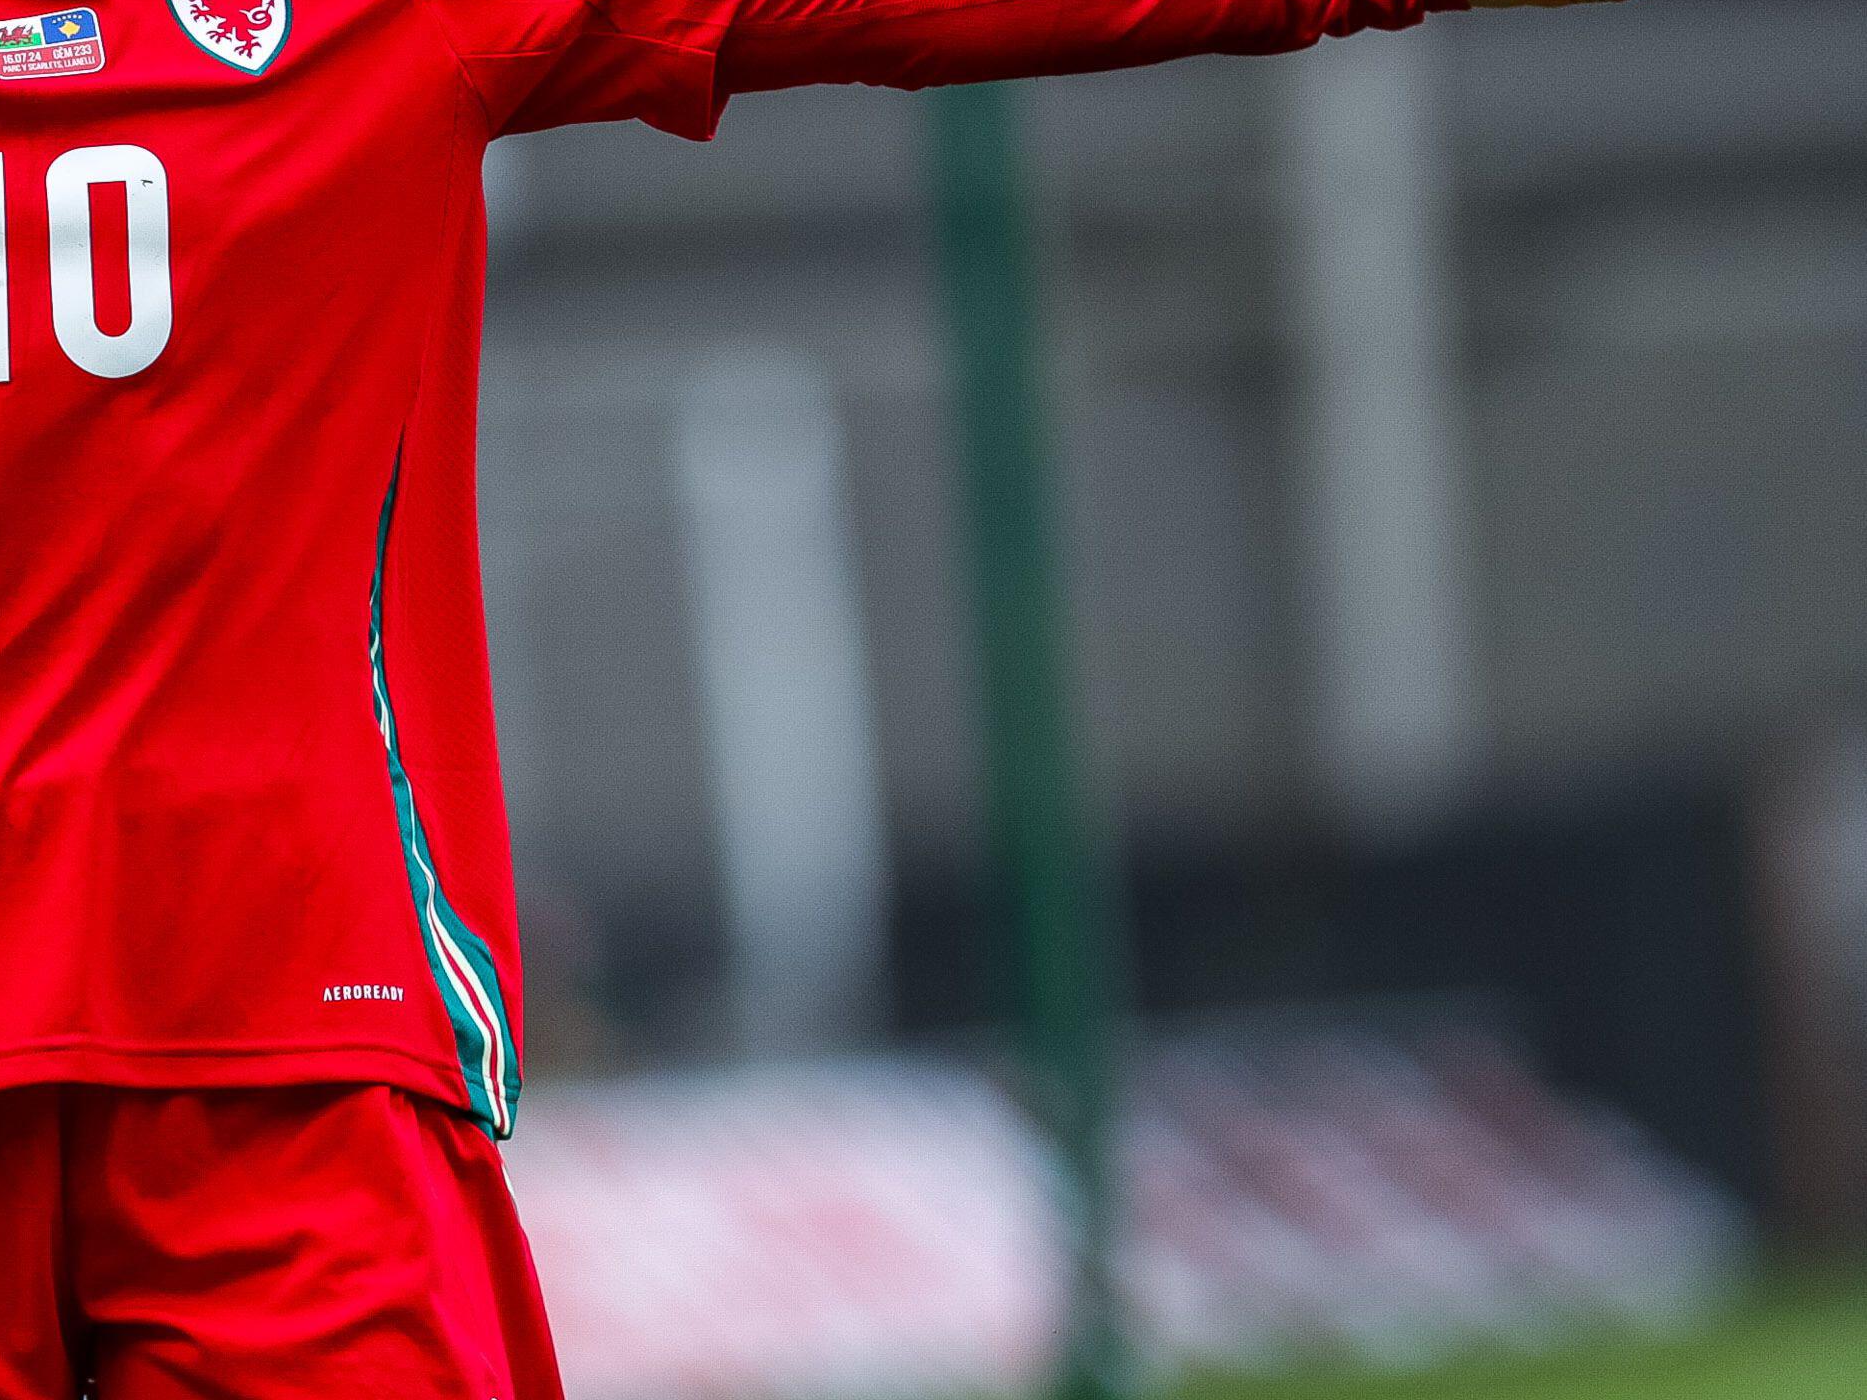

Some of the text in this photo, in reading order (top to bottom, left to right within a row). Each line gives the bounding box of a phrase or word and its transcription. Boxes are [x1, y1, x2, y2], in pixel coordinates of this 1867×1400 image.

[74, 44, 92, 57] 233
[2, 52, 41, 64] 16.07.24
[2, 64, 22, 73] PARC
[323, 985, 404, 1002] AEROREADY
